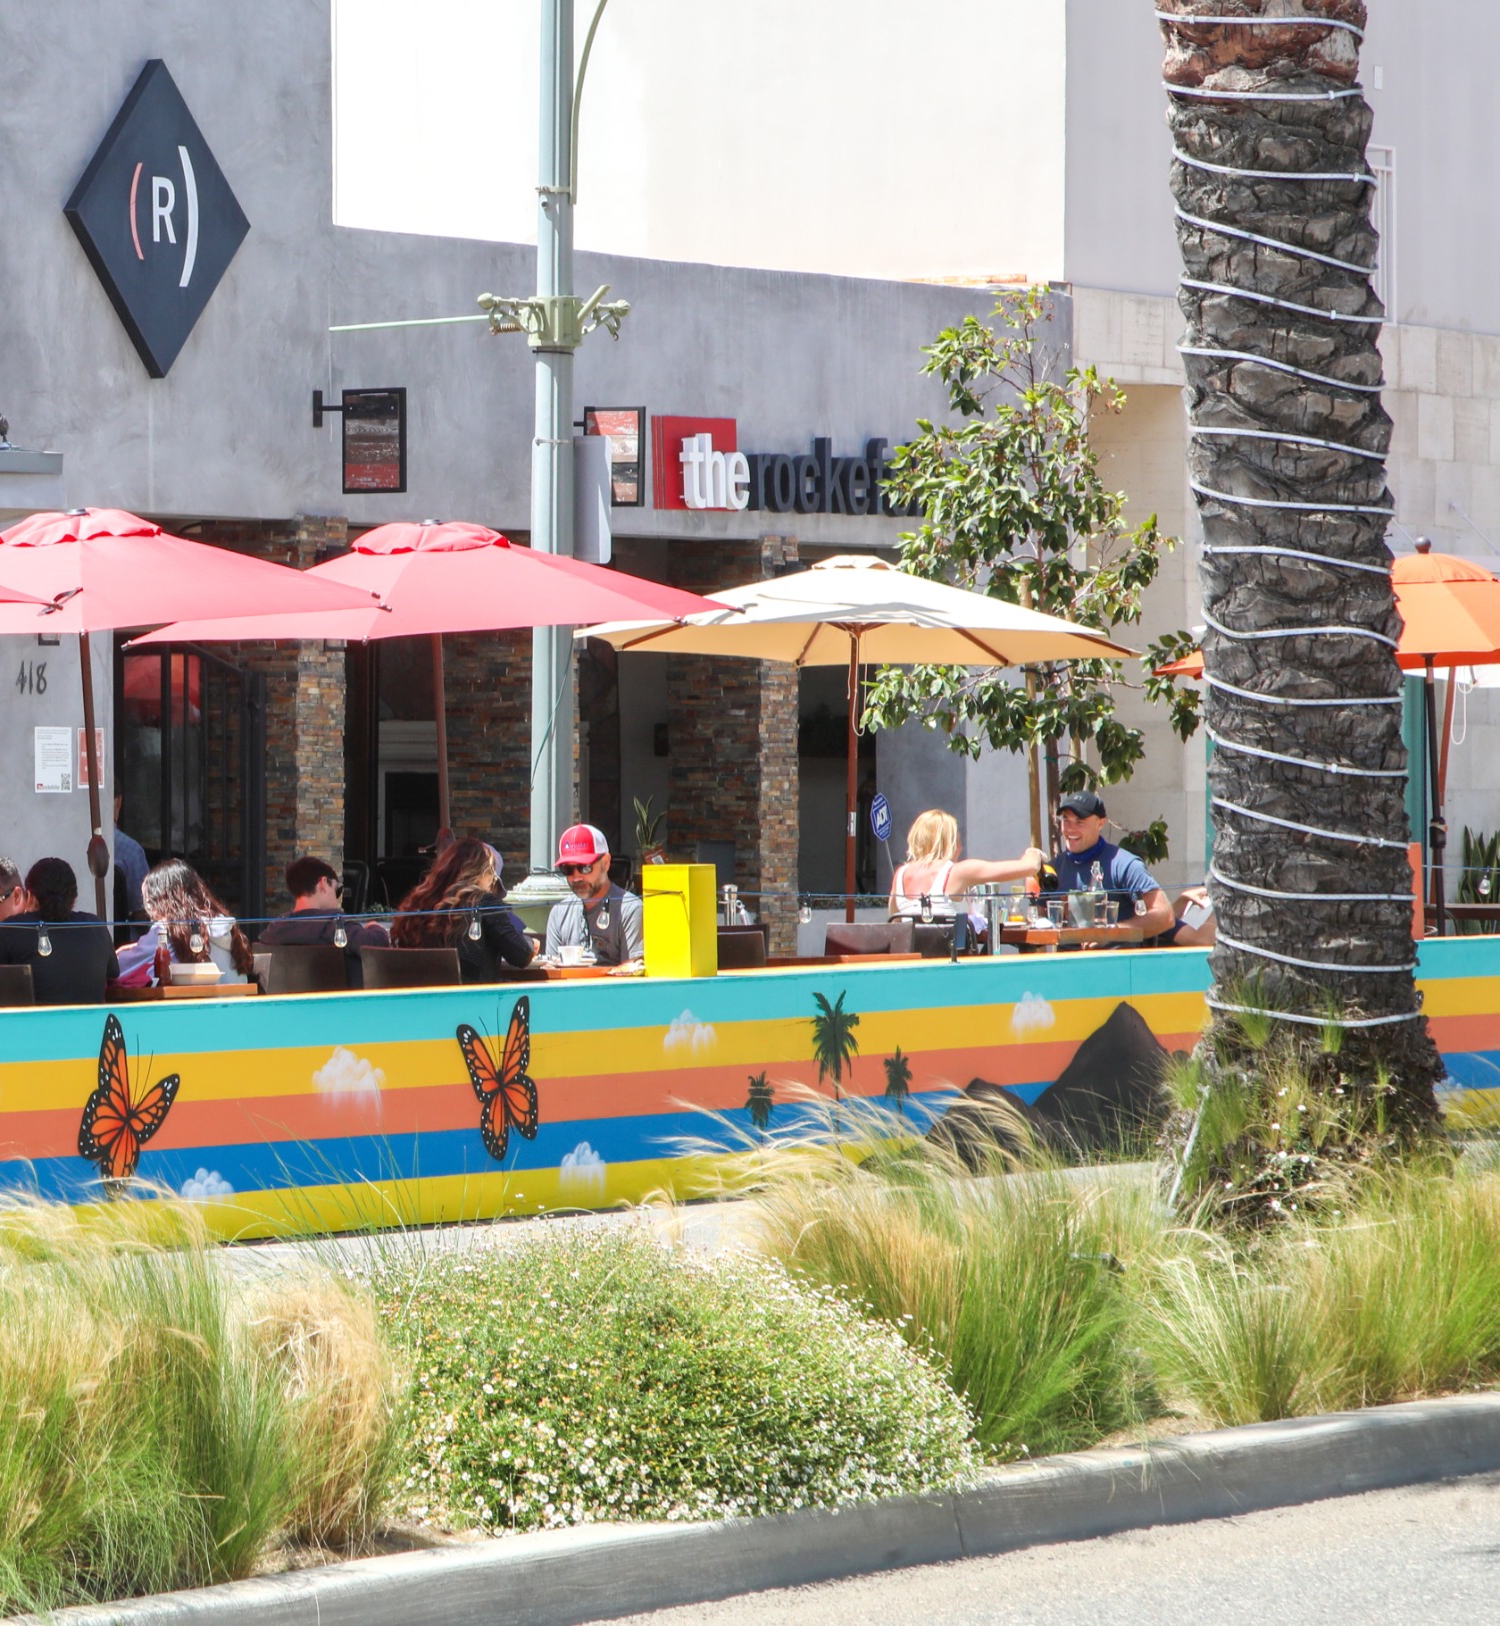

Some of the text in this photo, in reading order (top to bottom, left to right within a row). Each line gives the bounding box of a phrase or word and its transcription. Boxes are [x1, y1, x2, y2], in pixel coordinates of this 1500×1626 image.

[679, 432, 926, 517] the rockef
[15, 660, 47, 695] 418
